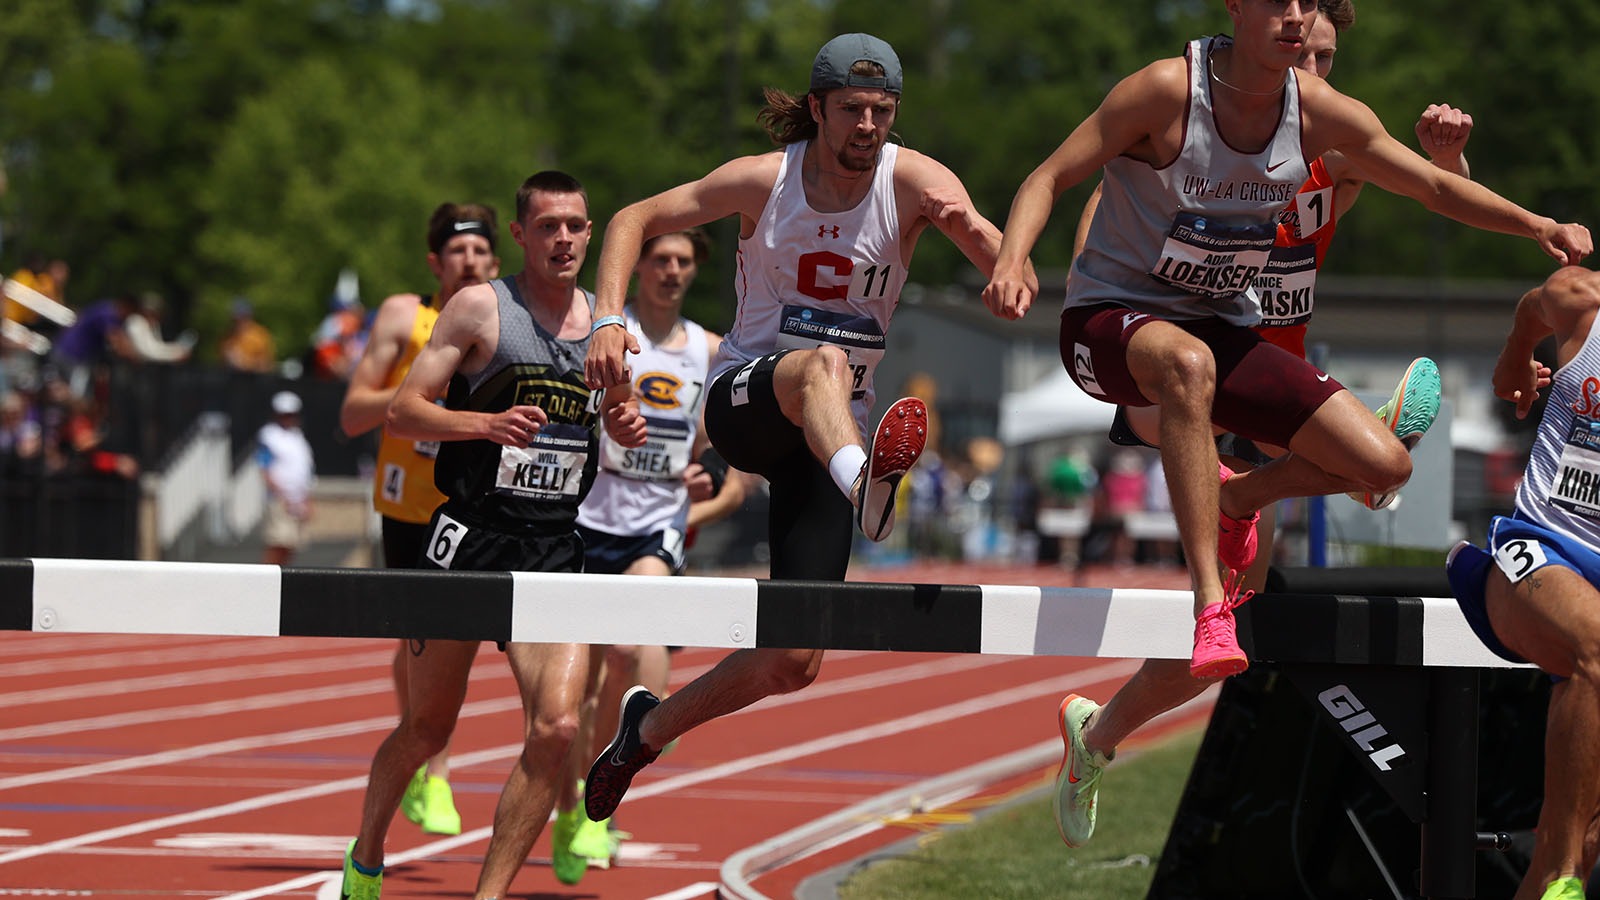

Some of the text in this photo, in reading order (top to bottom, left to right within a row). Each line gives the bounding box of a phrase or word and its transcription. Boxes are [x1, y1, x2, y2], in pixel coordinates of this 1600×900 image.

[1183, 175, 1294, 202] UW-LA CROSSE
[1307, 192, 1323, 229] 1
[1189, 232, 1210, 243] TRACK
[797, 251, 853, 301] C
[1159, 257, 1260, 290] LOENSER
[1204, 254, 1237, 266] ADAM
[1268, 257, 1315, 268] CHAMPIONSHIPS
[863, 264, 892, 297] 11
[1254, 286, 1311, 317] ASKI
[799, 322, 819, 333] TRACK
[824, 327, 841, 337] FIELD
[841, 331, 884, 342] CHAMPIONSHIPS
[1075, 353, 1097, 386] 12
[692, 381, 703, 414] 7
[538, 452, 558, 465] WILL
[622, 449, 672, 474] SHEA
[511, 463, 573, 492] KELLY
[433, 522, 460, 561] 6
[1504, 540, 1535, 578] 3
[1317, 684, 1406, 772] GILL
